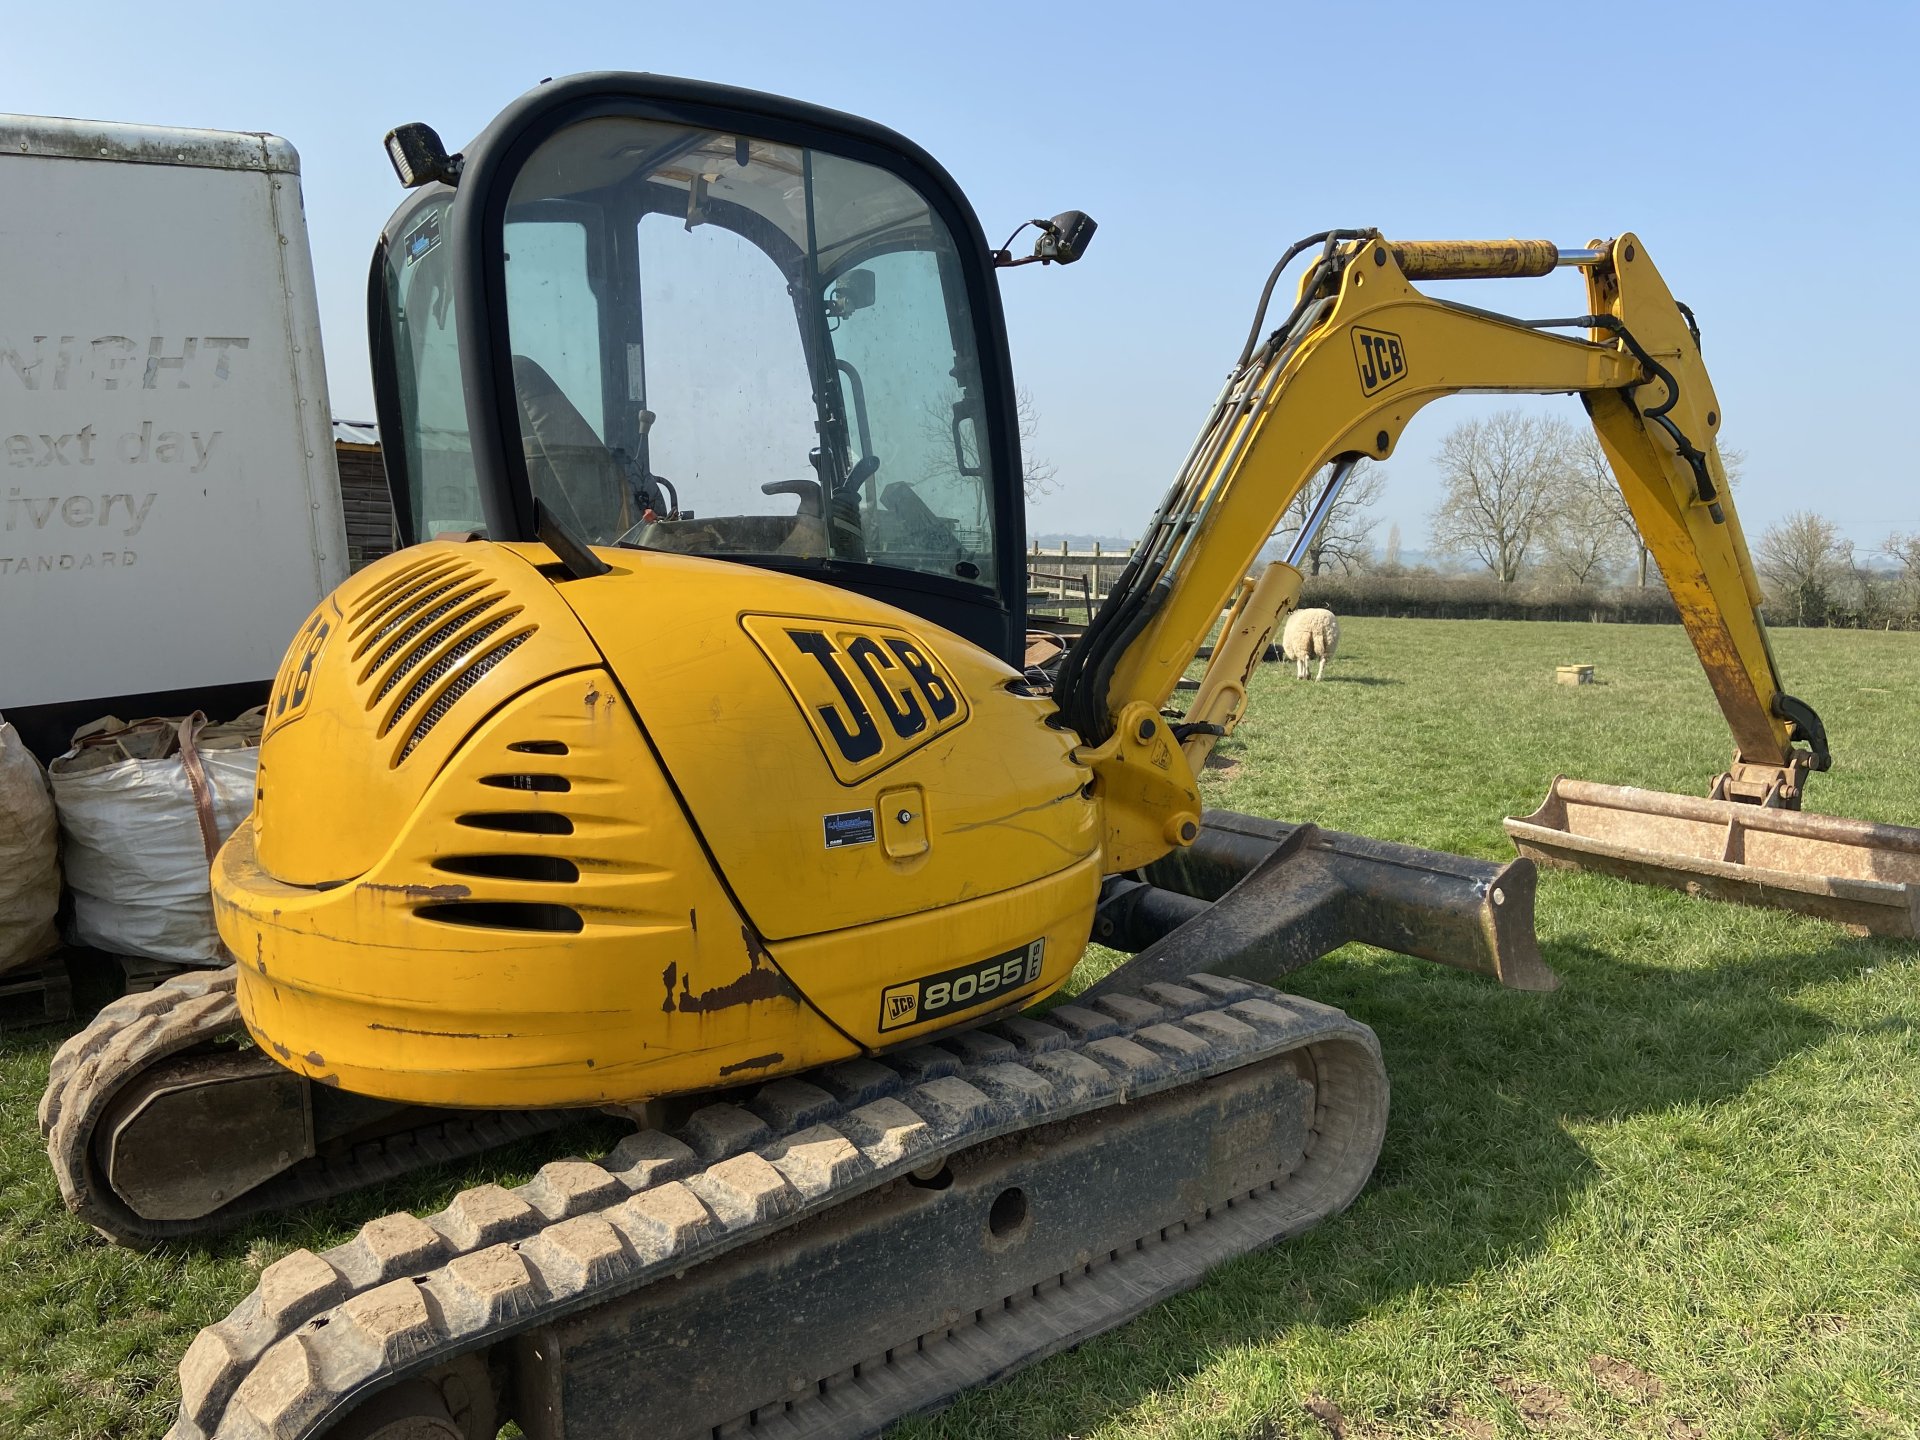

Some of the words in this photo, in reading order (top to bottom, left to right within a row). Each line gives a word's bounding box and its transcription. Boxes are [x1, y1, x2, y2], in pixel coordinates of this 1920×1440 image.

[1360, 333, 1404, 389] JCB
[117, 421, 225, 474] day
[785, 629, 959, 764] JCB
[891, 996, 915, 1018] JCB
[923, 956, 1024, 1011] 8055
